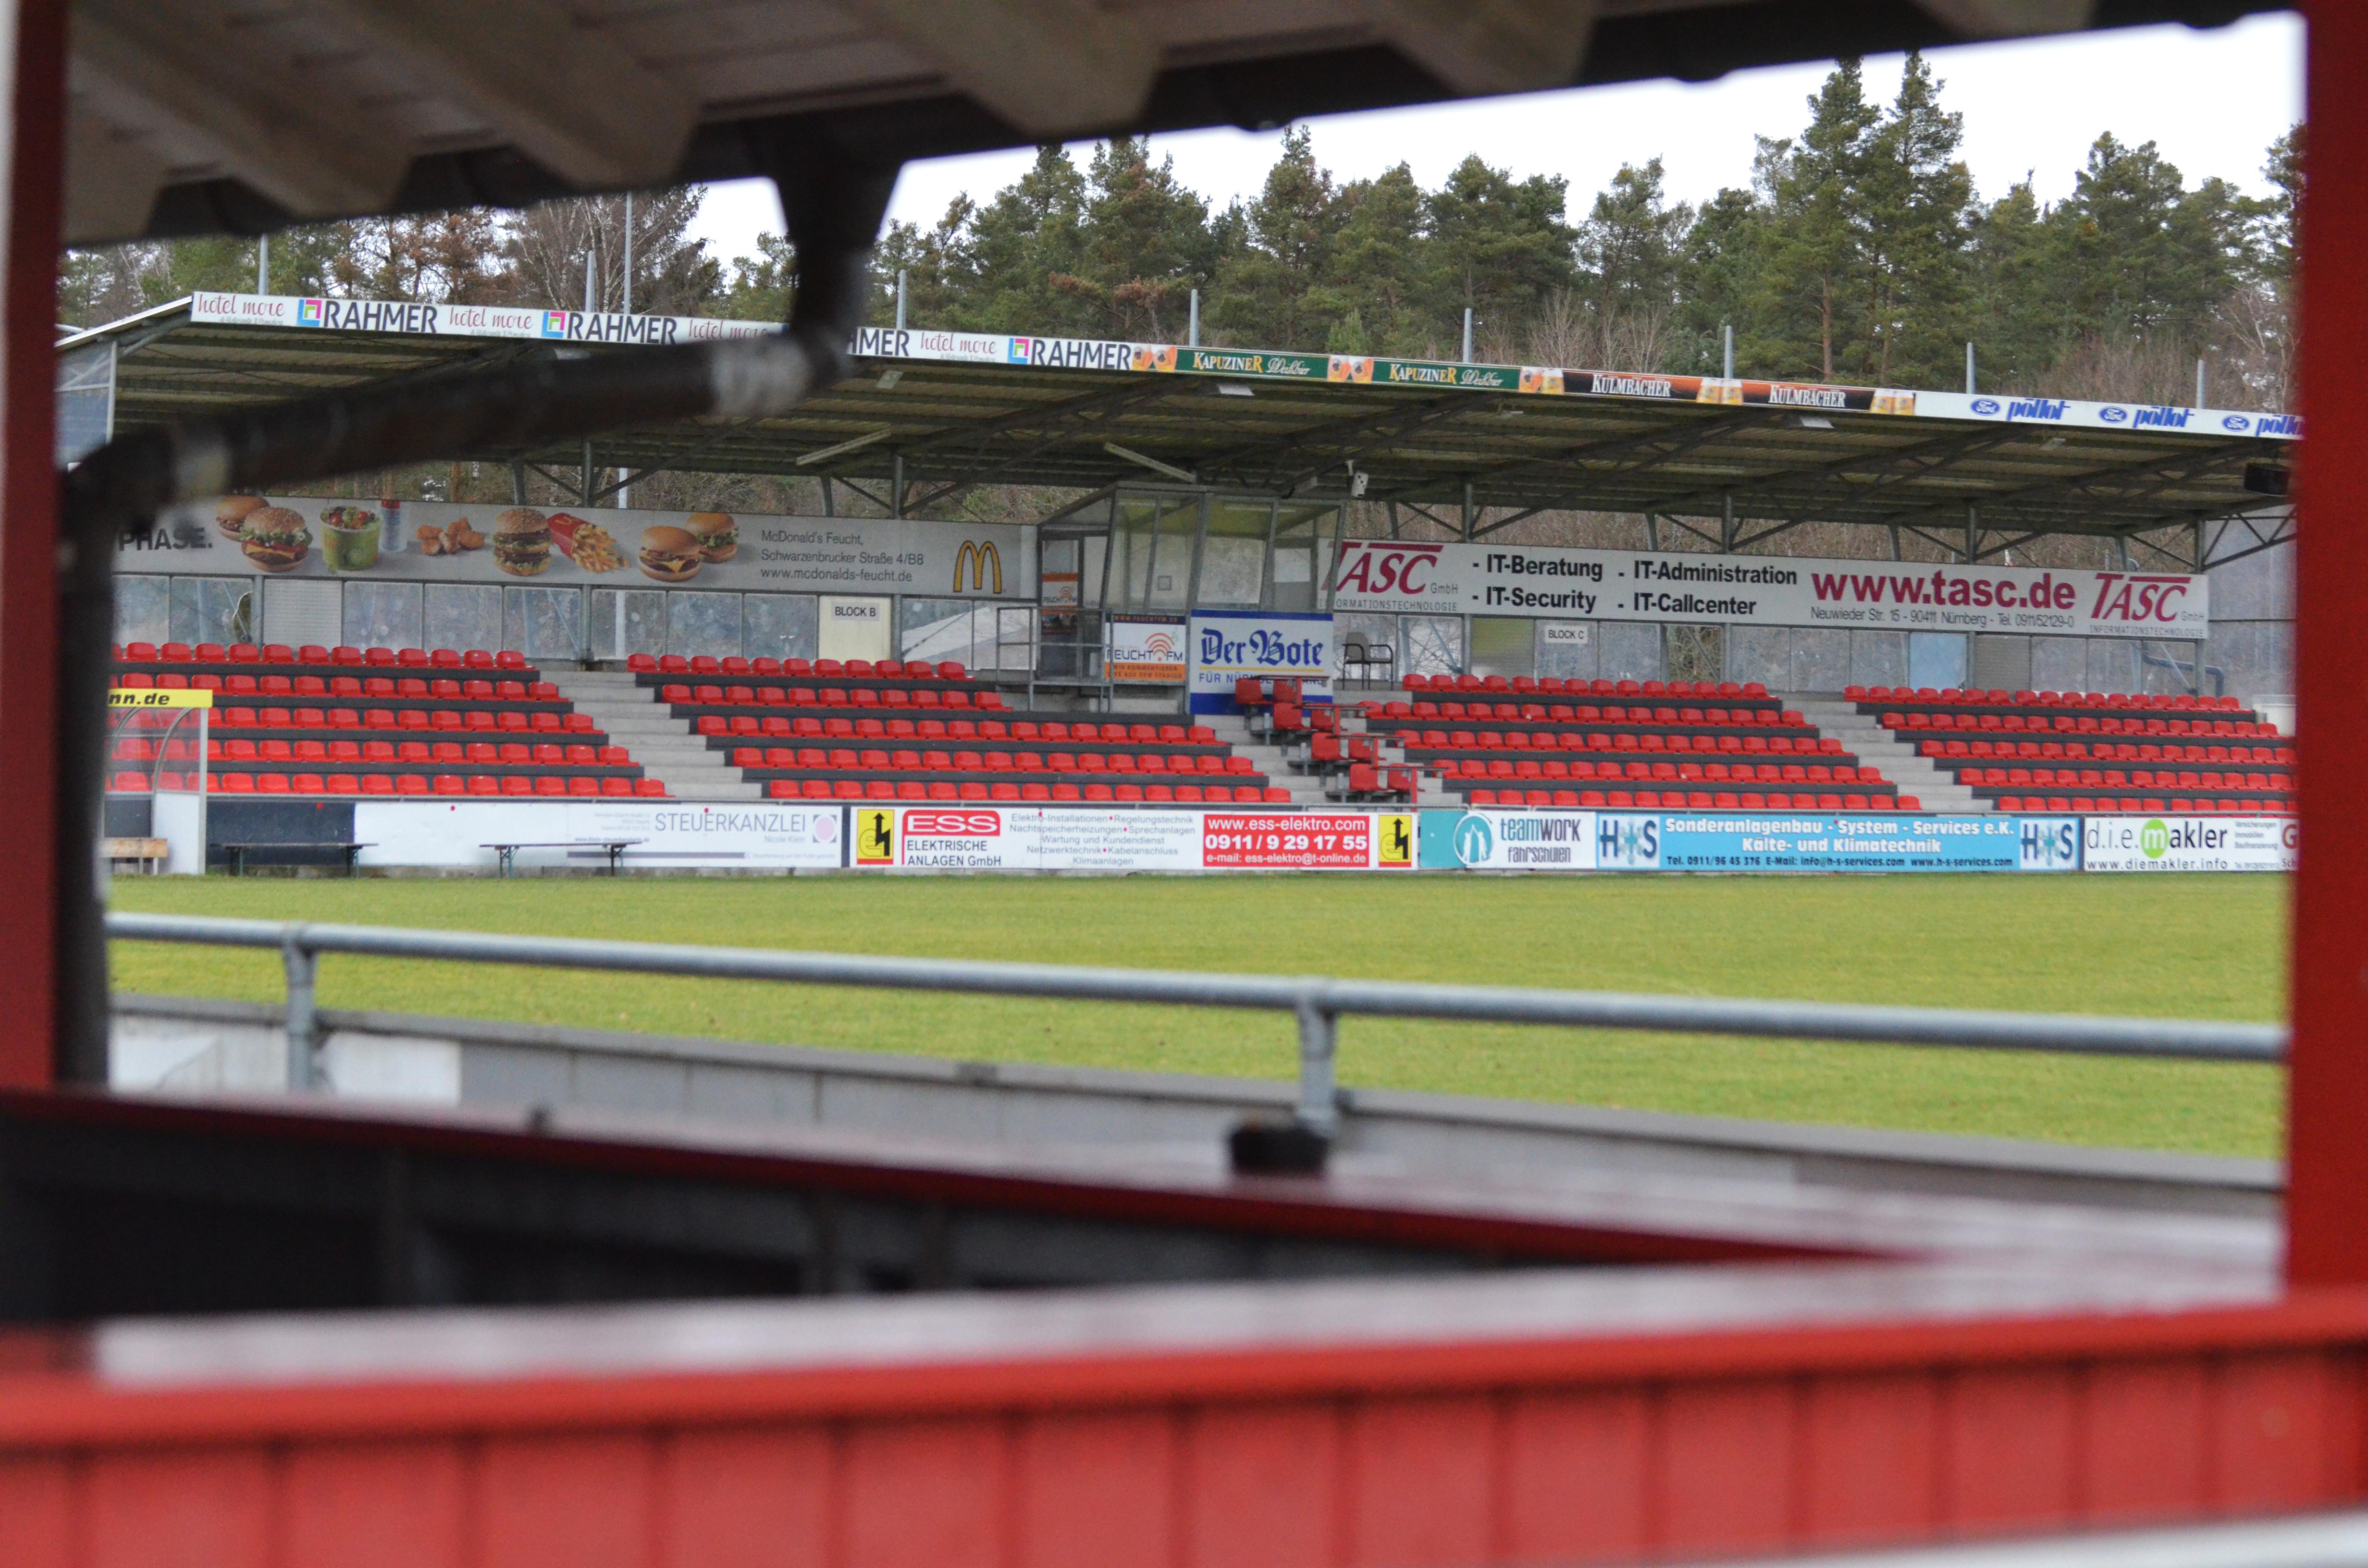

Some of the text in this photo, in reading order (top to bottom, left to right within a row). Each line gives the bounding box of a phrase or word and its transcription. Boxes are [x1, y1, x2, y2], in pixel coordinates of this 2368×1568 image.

[199, 294, 236, 314] hotel
[324, 301, 437, 333] RAHMER
[449, 306, 486, 327] hotel
[567, 313, 678, 344] RAHMER
[689, 319, 724, 339] hotel
[921, 331, 954, 351] hotel
[1032, 339, 1131, 369] RAHMER
[1192, 352, 1263, 373] KAPUZINER
[1390, 364, 1457, 385] KAPUZINER
[1591, 373, 1671, 397] KULMBACHER
[1768, 385, 1847, 408] KULMBACHER
[761, 530, 863, 546] McDonald's Feucht,
[761, 549, 924, 565] Schwarzenbrucker Straße 4/B8
[761, 567, 913, 582] www.mcdonalds-feucht.de
[1487, 554, 1603, 582] IT-Beratung
[1635, 561, 1797, 585] IT-Administration
[1431, 583, 1458, 594] GmbH
[1811, 570, 2076, 609] www.tasc.de
[1487, 587, 1596, 614] IT-Security
[1634, 593, 1757, 615] IT-Callcenter
[2091, 573, 2191, 622] TASC
[835, 607, 876, 617] BLOCK B
[1811, 607, 1866, 621] Neuwieder
[1869, 609, 1884, 621] Str.
[1890, 610, 1899, 622] 15
[1548, 629, 1584, 640] BLOCK C
[1201, 627, 1323, 666] Der Bote
[1167, 651, 1183, 662] FM
[1199, 671, 1221, 683] FÜR
[655, 813, 805, 833] STEUERKANZLEI
[907, 815, 997, 833] ESS
[1114, 815, 1194, 824] Regelungstechnik
[1208, 818, 1365, 831] www.ess-elektro.com
[1665, 818, 1823, 835] Sonderanlagenbau
[1838, 820, 1898, 835] System
[1913, 821, 1980, 835] Services
[1984, 821, 2014, 835] e.K.
[1010, 824, 1196, 835] Nachtspeicherheizungen Sprechanlagen
[1500, 818, 1580, 842] teamwork
[907, 840, 987, 851] ELEKTRISCHE
[1041, 836, 1165, 845] Wartung und Kundendienst
[1283, 835, 1308, 850] 29
[1313, 835, 1337, 850] 17
[1343, 835, 1367, 850] 55
[1742, 837, 1941, 853] Kälte- und Klimatechnik
[1027, 846, 1178, 855] Netzwerktechnik Kabelanschluss
[908, 856, 1001, 866] ANLAGEN GmbH
[1073, 857, 1134, 866] Klimaanlagen
[1207, 854, 1366, 865] e-mail: ess-elektro@t-online.de
[2086, 858, 2228, 870] www.diemakler.info
